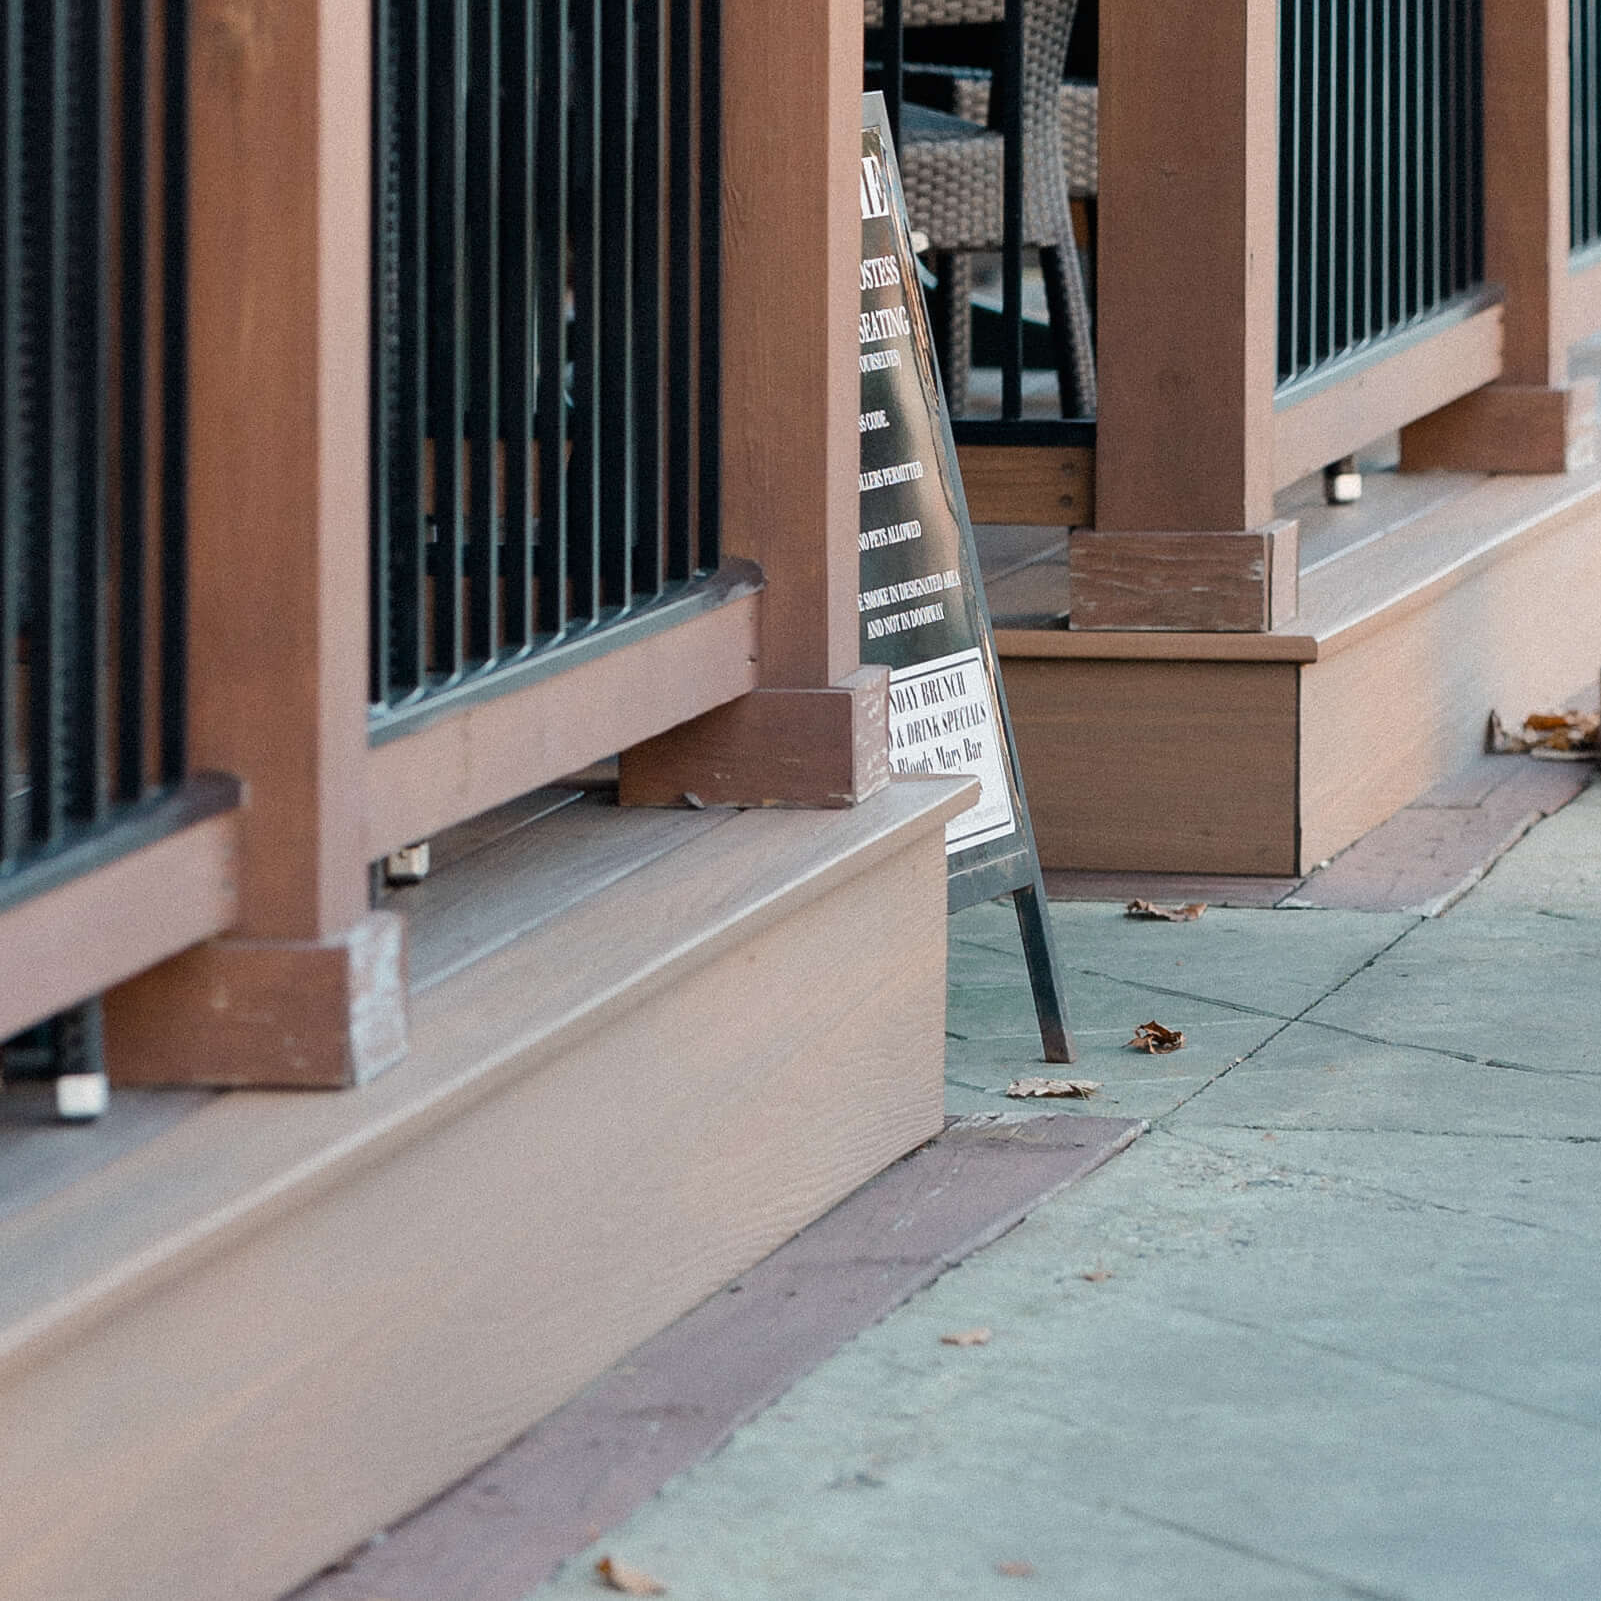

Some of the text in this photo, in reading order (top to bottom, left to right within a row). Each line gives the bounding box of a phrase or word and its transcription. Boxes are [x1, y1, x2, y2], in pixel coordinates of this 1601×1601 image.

[868, 527, 888, 549] PETS
[887, 520, 921, 544] ALLOWED
[867, 616, 884, 640] AND
[883, 613, 901, 635] NOT
[920, 671, 966, 706] BRUNCH
[896, 725, 904, 749] &
[906, 715, 940, 747] DRINK
[941, 702, 986, 736] SPECIALS
[935, 745, 962, 773] Mary
[962, 736, 982, 763] Bar
